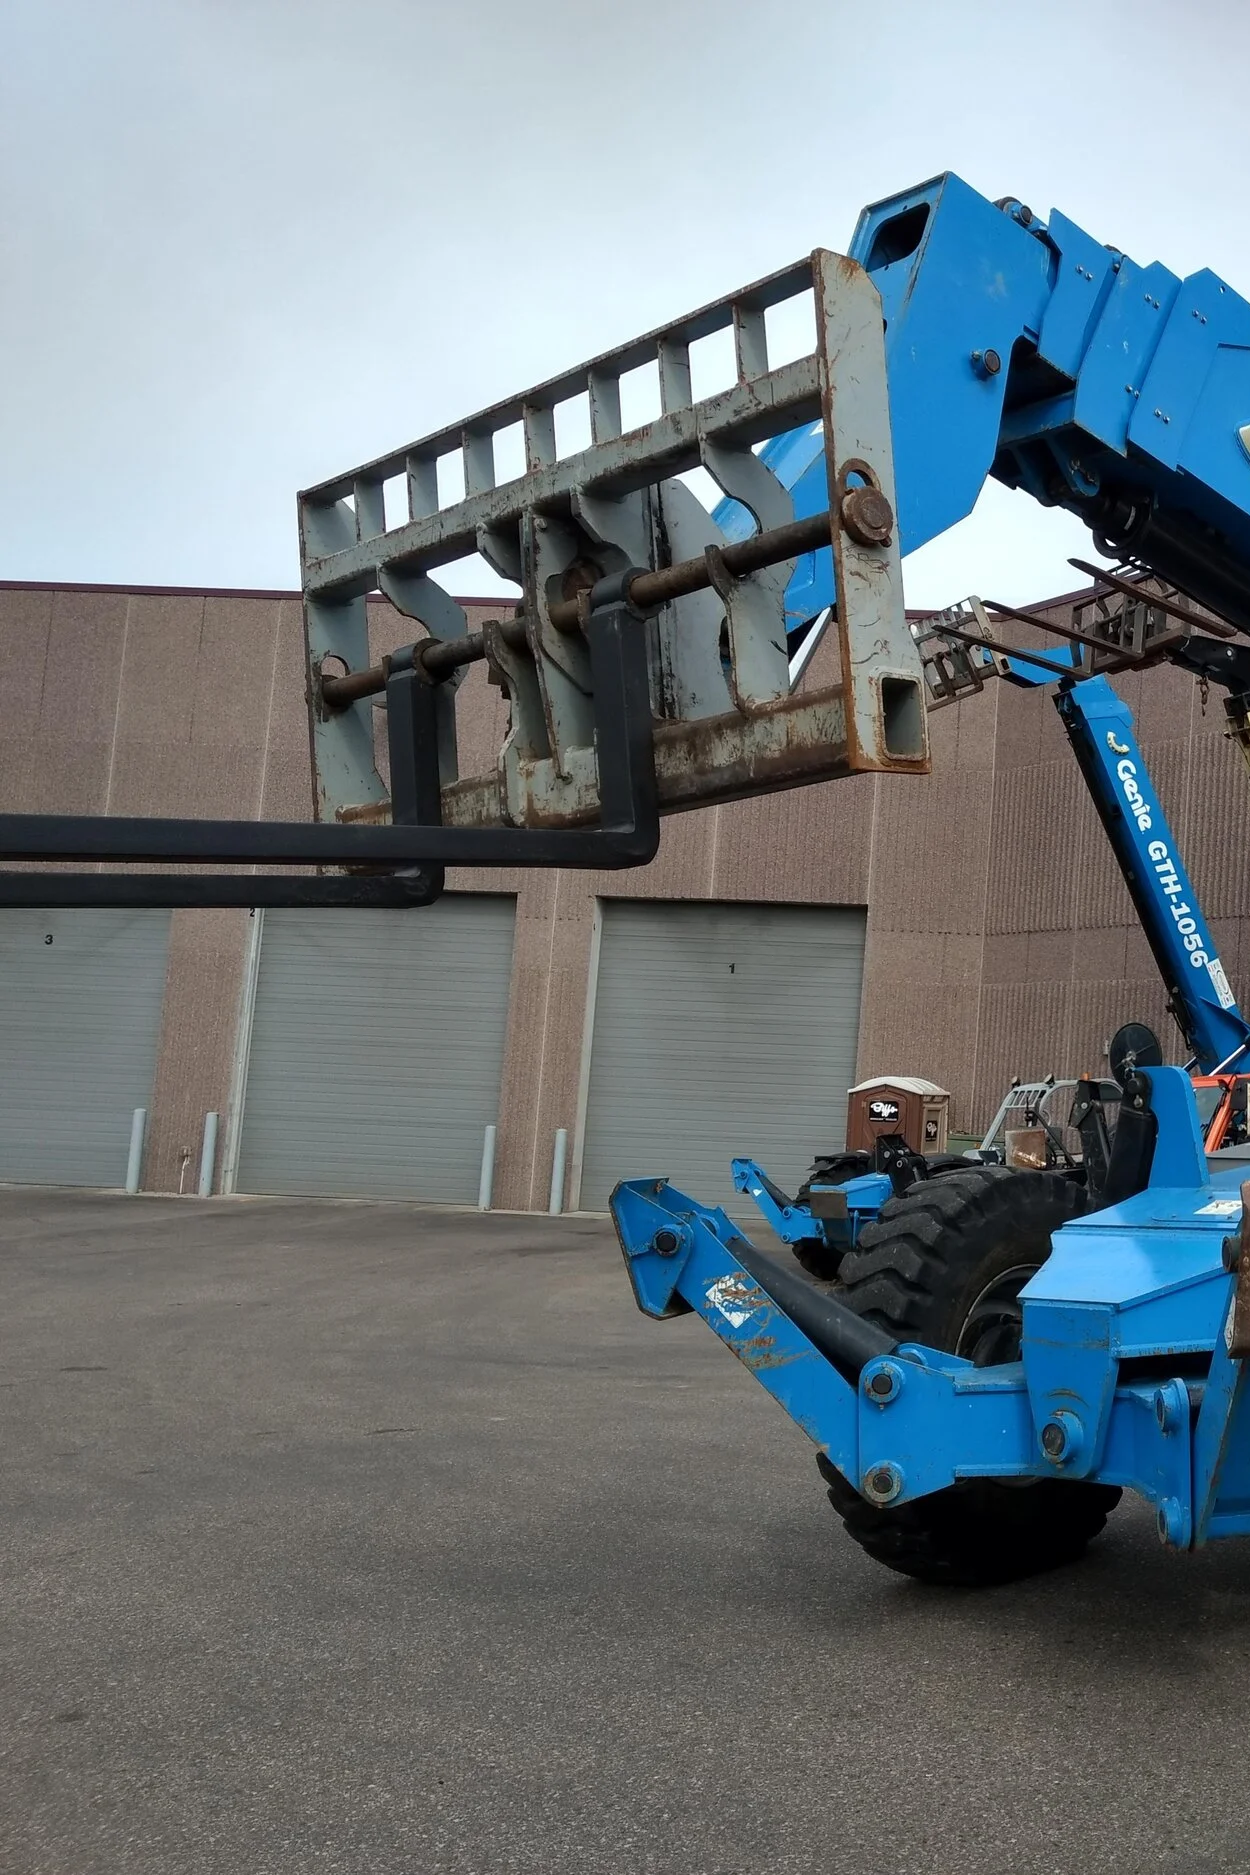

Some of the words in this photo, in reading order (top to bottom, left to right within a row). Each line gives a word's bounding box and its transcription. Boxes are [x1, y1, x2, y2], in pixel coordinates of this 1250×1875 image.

[1117, 759, 1152, 832] Genie
[1148, 840, 1209, 968] GTH-1056
[44, 934, 54, 945] 3
[728, 962, 735, 974] 1
